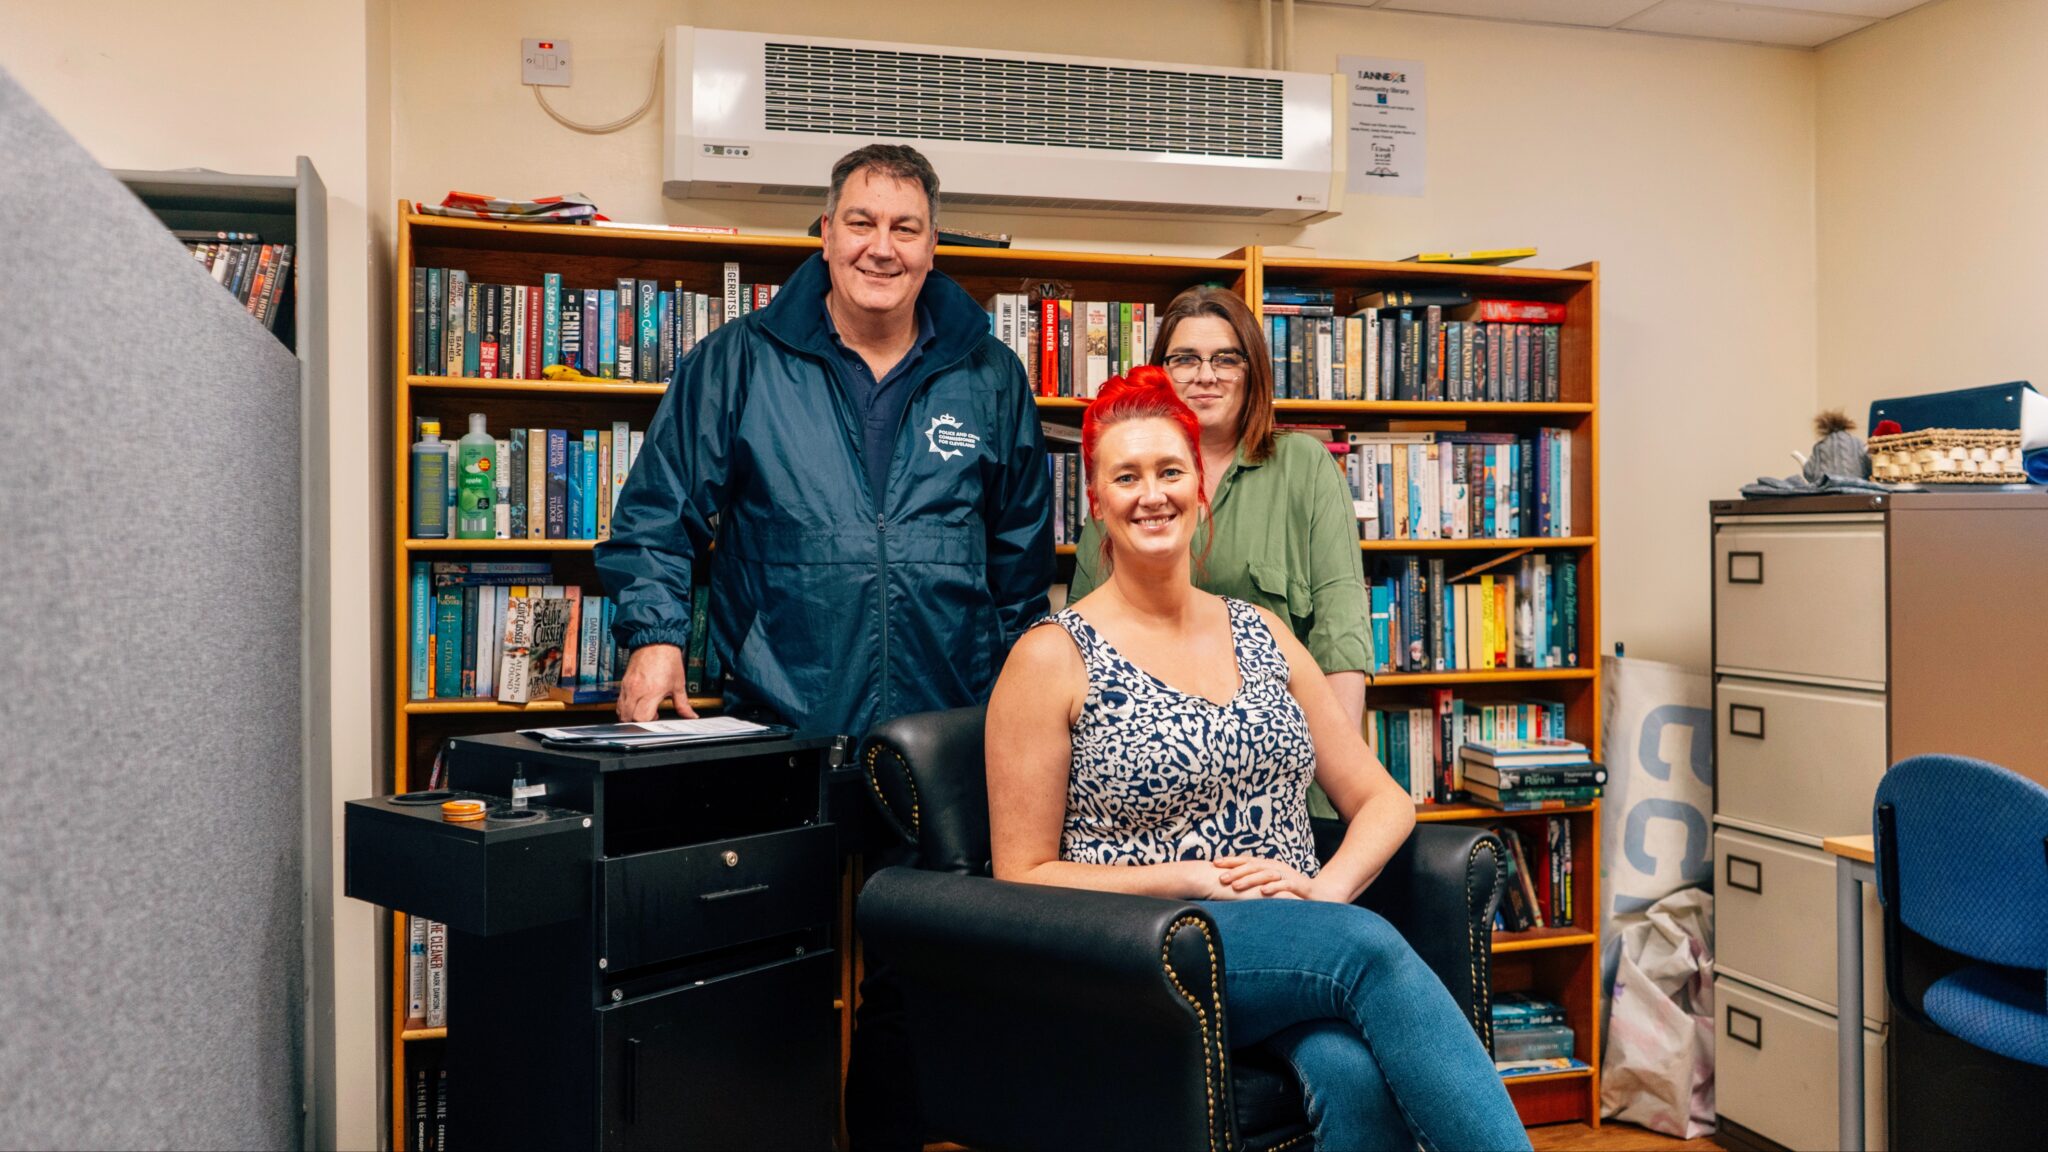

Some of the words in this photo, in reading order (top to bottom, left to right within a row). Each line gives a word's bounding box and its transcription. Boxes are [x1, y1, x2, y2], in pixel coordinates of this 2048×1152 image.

[1355, 84, 1389, 94] Community
[503, 287, 512, 305] DICK
[546, 286, 558, 325] Stephen
[642, 284, 652, 318] CUCKOO'S
[502, 306, 512, 336] FRANCIS
[561, 311, 580, 352] CHILD
[641, 319, 652, 349] CALLING
[546, 328, 556, 346] Fry
[1046, 326, 1054, 352] MEYER
[619, 345, 632, 361] MAY
[1463, 351, 1472, 379] WARD
[1490, 352, 1499, 380] WARD
[619, 362, 632, 377] ACK
[950, 440, 976, 449] CLEVELAND
[1367, 466, 1375, 489] WOOD
[417, 568, 425, 603] RICHARD
[517, 602, 528, 619] CLIVE
[542, 608, 561, 626] CLIVE
[416, 604, 425, 644] HAMMOND
[514, 619, 526, 645] CUSSLER
[534, 623, 565, 647] CUSSLER
[589, 617, 597, 635] DAN
[444, 640, 453, 679] CITADEL
[588, 635, 597, 666] BROWN
[507, 663, 517, 690] FOUND
[514, 660, 523, 694] ATLANTIS
[1525, 775, 1556, 785] Rankin
[430, 936, 444, 970] CLEANER
[433, 971, 441, 986] MARK
[433, 987, 441, 1010] DAWSON
[417, 1084, 427, 1120] LEHANE
